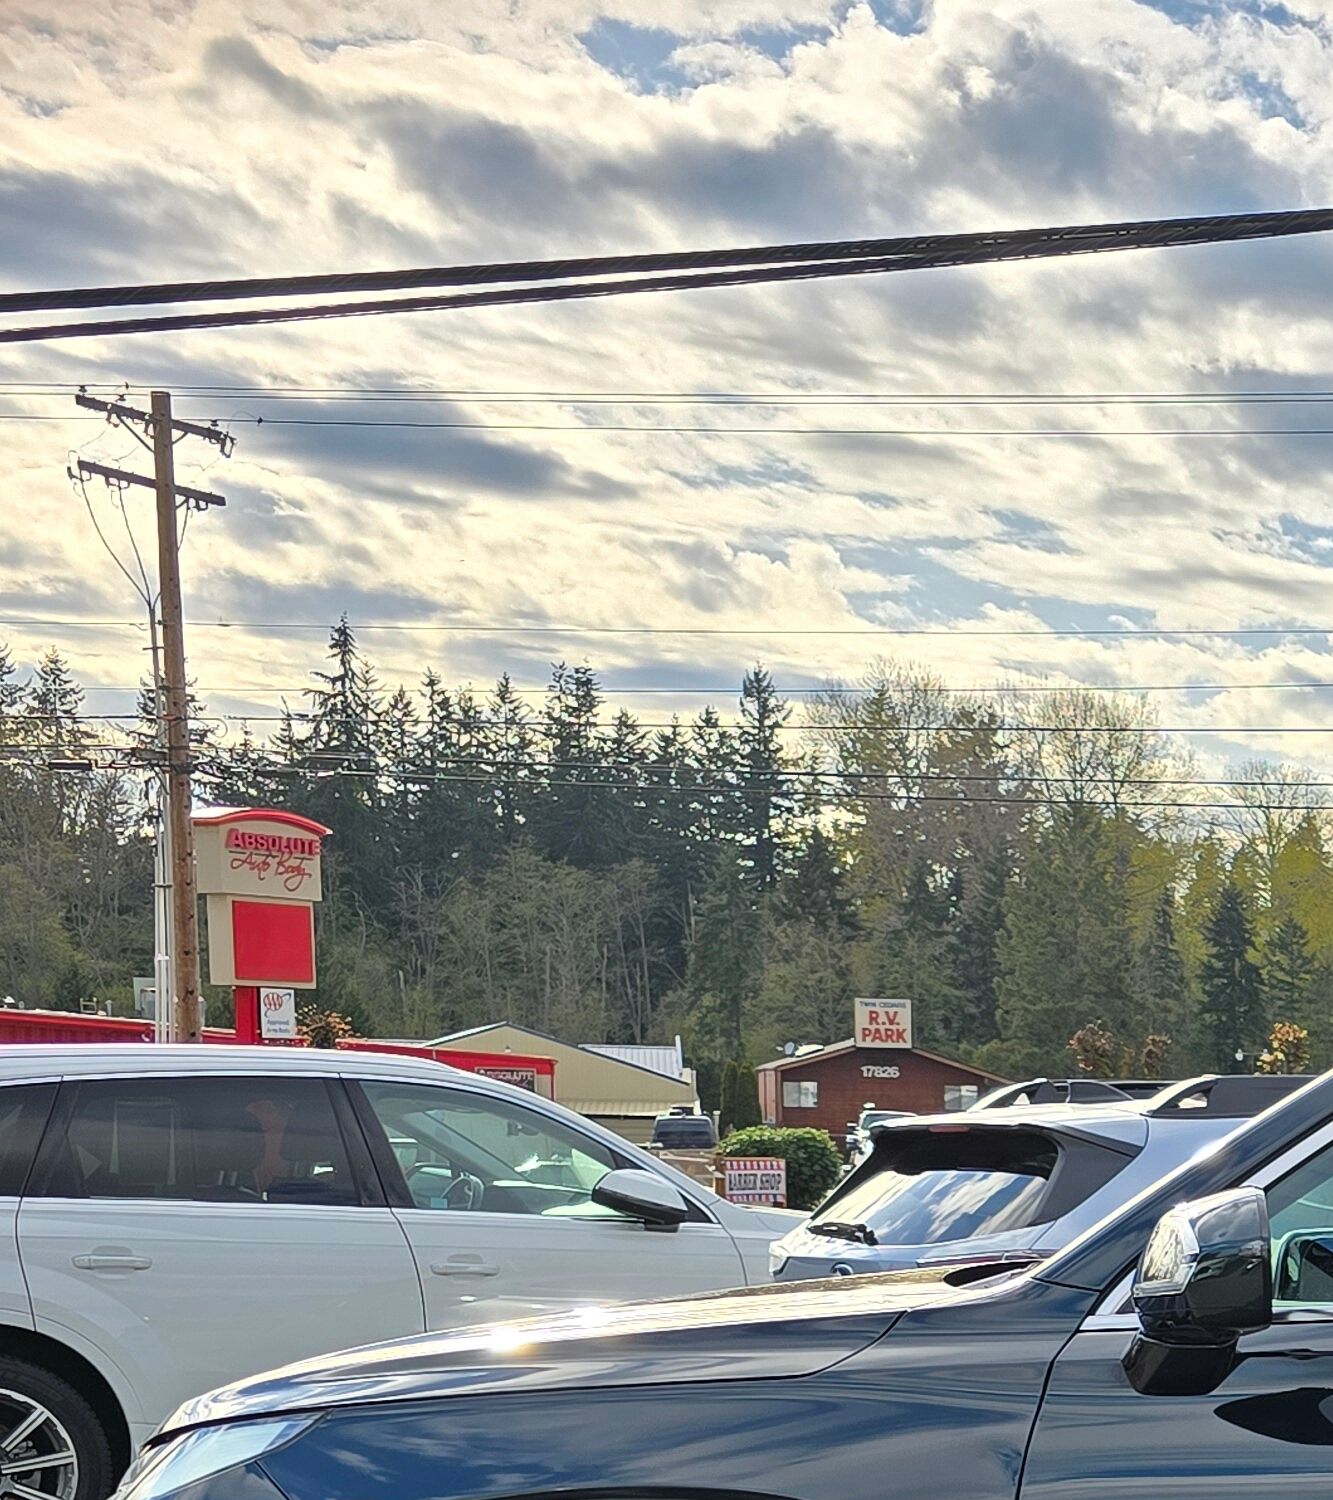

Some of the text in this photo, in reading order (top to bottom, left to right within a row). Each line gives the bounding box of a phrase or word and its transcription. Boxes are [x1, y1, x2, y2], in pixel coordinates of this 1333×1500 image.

[225, 828, 321, 856] ABSOLUTE
[231, 848, 312, 892] Auto Body
[868, 1010, 901, 1026] R.V.
[862, 1027, 907, 1043] PARK
[860, 1065, 900, 1078] 17826
